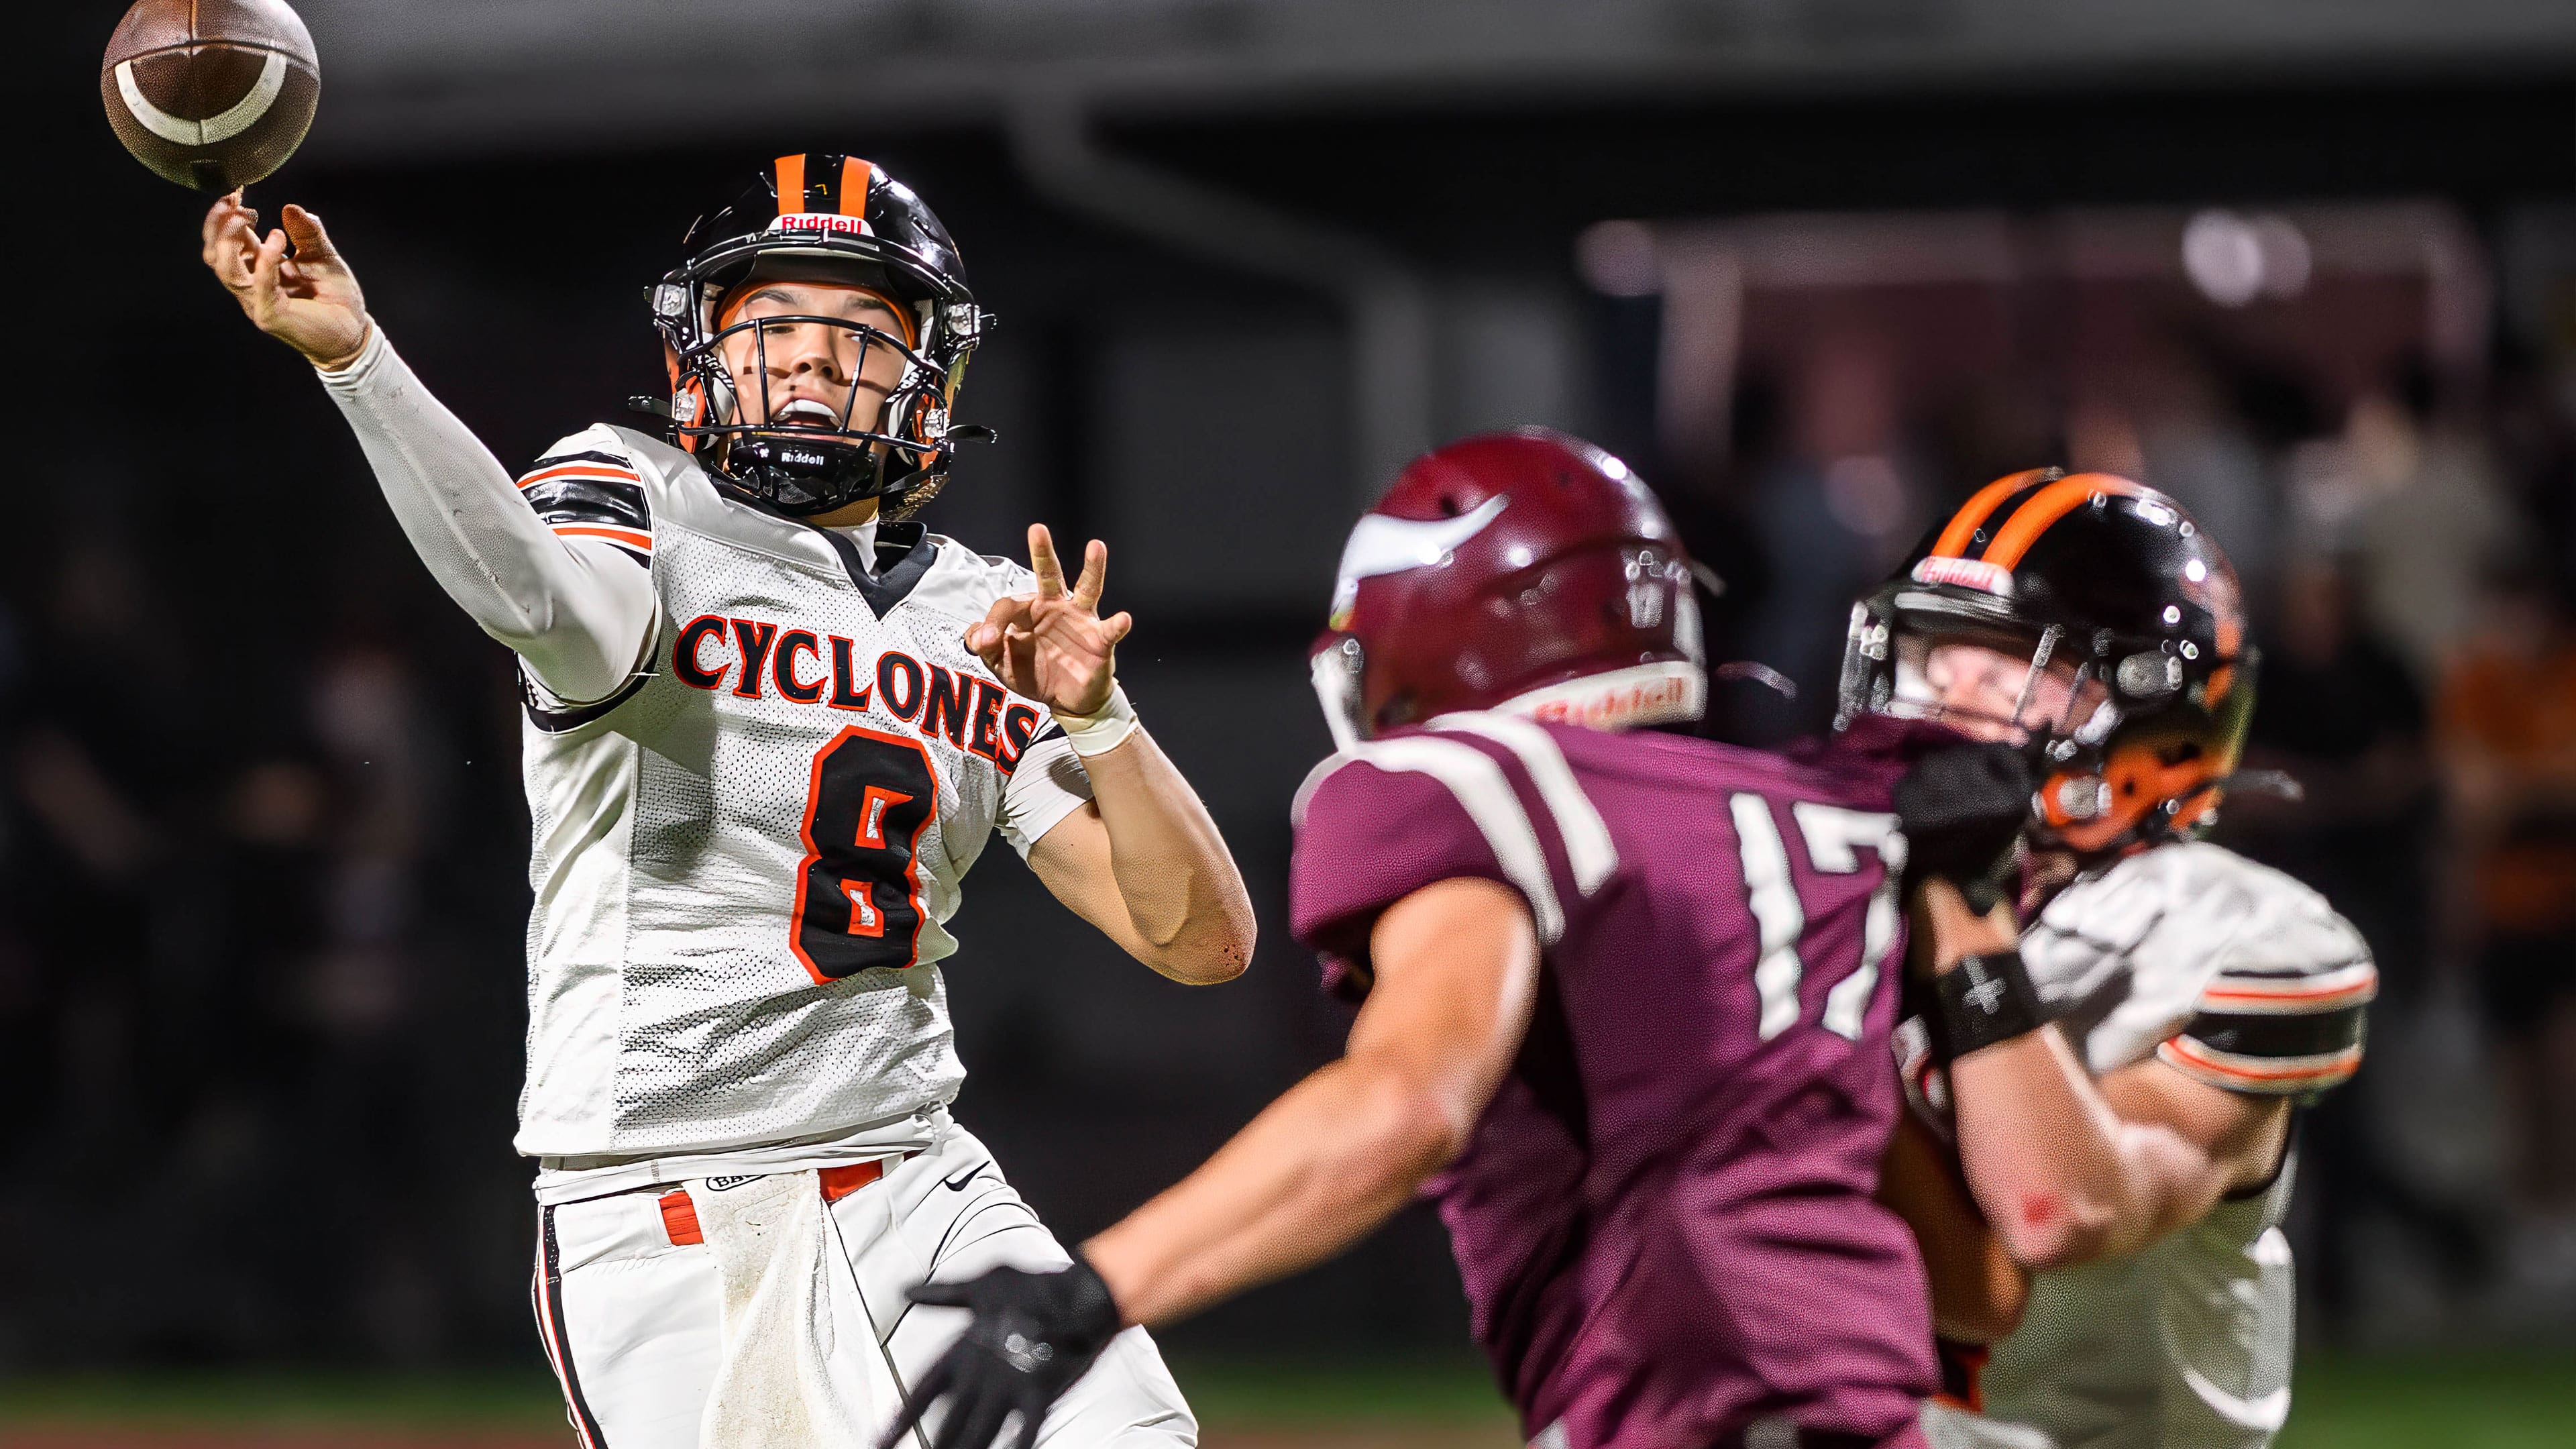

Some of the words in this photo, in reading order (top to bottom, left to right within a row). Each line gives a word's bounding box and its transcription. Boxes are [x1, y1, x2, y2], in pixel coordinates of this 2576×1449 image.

[782, 216, 862, 234] Riddell
[673, 614, 1040, 776] CYCLONES
[790, 724, 938, 986] 8
[1729, 792, 1910, 1042] 17
